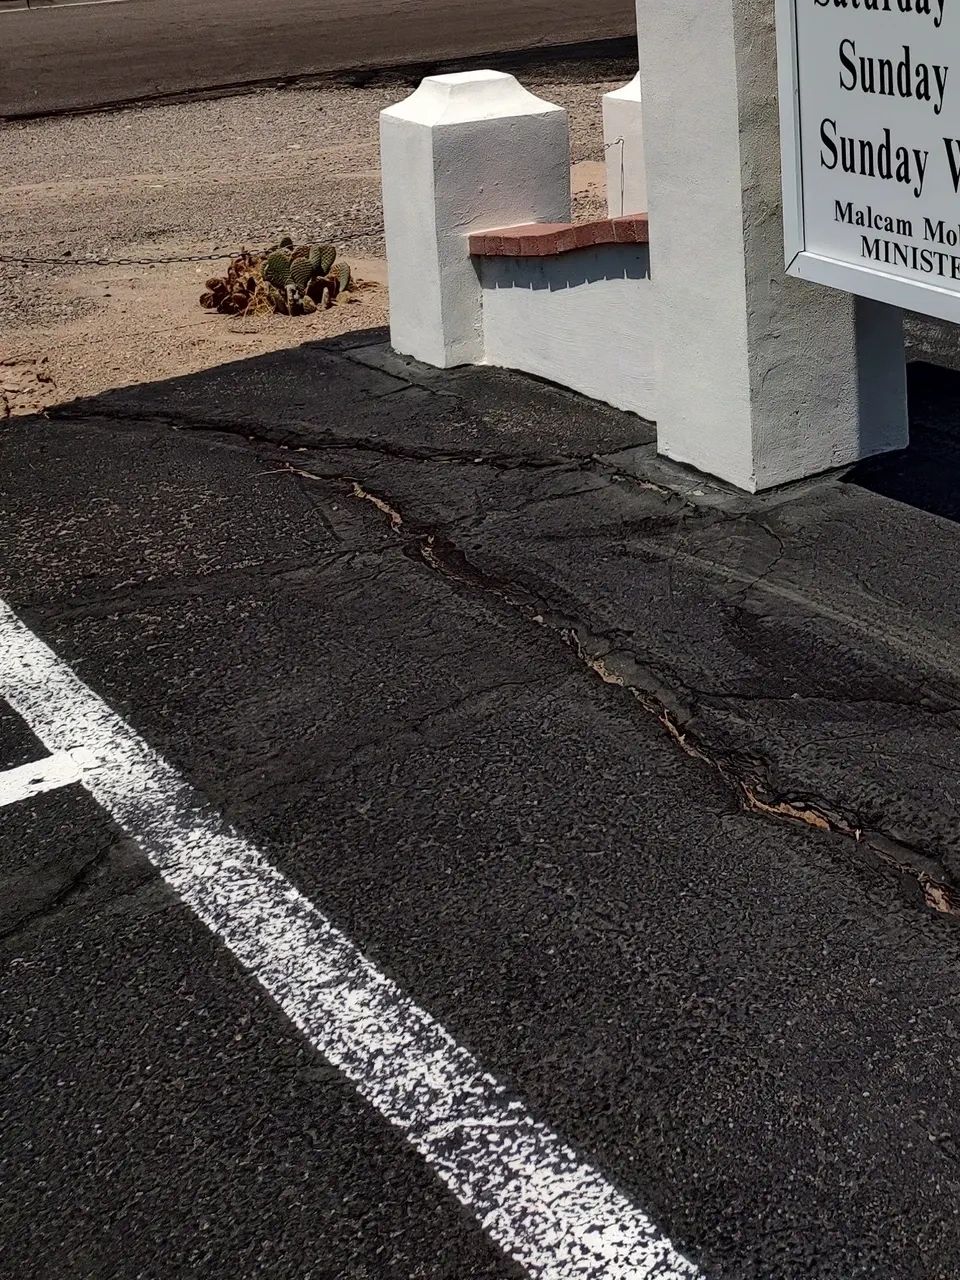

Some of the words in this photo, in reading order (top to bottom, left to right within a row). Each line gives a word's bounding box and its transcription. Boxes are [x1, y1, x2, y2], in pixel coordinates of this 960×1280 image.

[838, 38, 949, 116] Sunday
[820, 118, 929, 199] Sunday
[833, 199, 914, 238] Malcam
